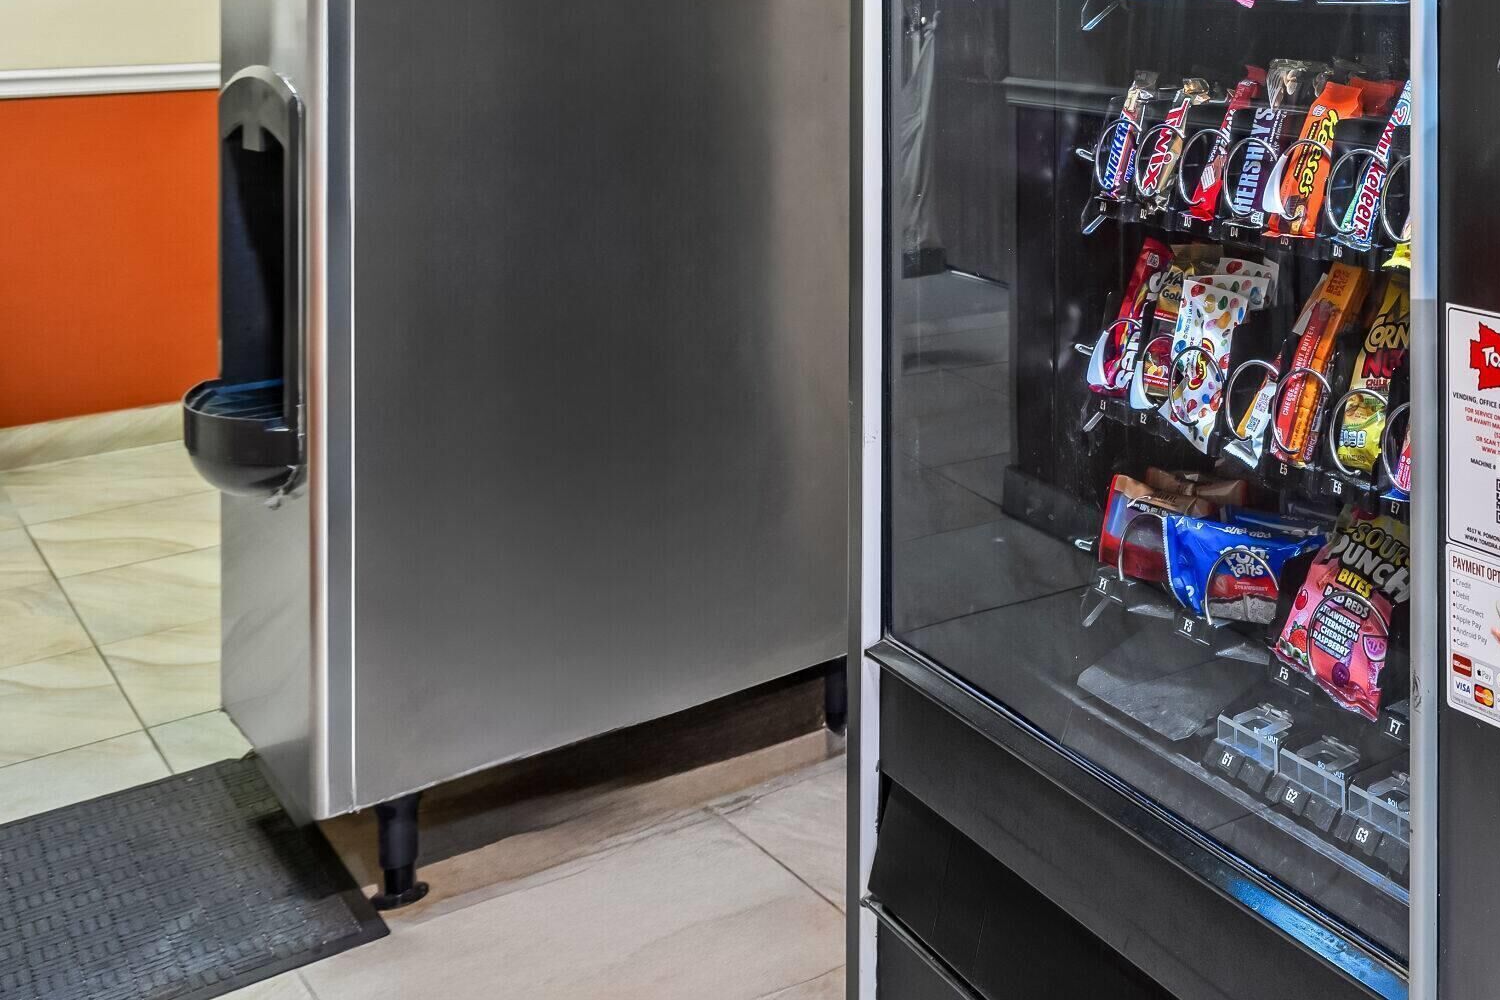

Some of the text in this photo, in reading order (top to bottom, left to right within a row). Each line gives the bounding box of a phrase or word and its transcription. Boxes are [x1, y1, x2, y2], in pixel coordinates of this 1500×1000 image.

[1233, 107, 1275, 215] HERSHEY'S
[1333, 246, 1342, 257] D6
[1453, 392, 1478, 404] VENDING,
[1479, 398, 1497, 409] OFFICE
[1475, 409, 1493, 420] SERVICE
[1484, 437, 1496, 447] SCAN
[1470, 458, 1492, 469] MACHINE
[1333, 481, 1342, 494] E6
[1452, 555, 1485, 579] PAYMENT
[1099, 577, 1107, 591] F1
[1337, 568, 1372, 598] BITES
[1456, 579, 1471, 590] Credit
[1456, 591, 1470, 601] Debit
[1345, 597, 1370, 619] REDS
[1456, 602, 1484, 619] USConnect
[1184, 618, 1193, 633] F3
[1321, 606, 1361, 631] STRAWBERRY
[1456, 615, 1482, 631] Apple Pay
[1316, 614, 1359, 642] WATERMELON
[1321, 625, 1347, 645] CHERRY
[1456, 626, 1488, 646] Android Pay
[1456, 638, 1469, 648] Cash
[1313, 631, 1350, 657] RASPBERRY
[1279, 666, 1289, 681] F5
[1455, 680, 1471, 694] VISA
[1390, 719, 1401, 734] F7
[1222, 753, 1232, 767] G1
[1285, 789, 1298, 804] G2
[1355, 828, 1369, 844] G3
